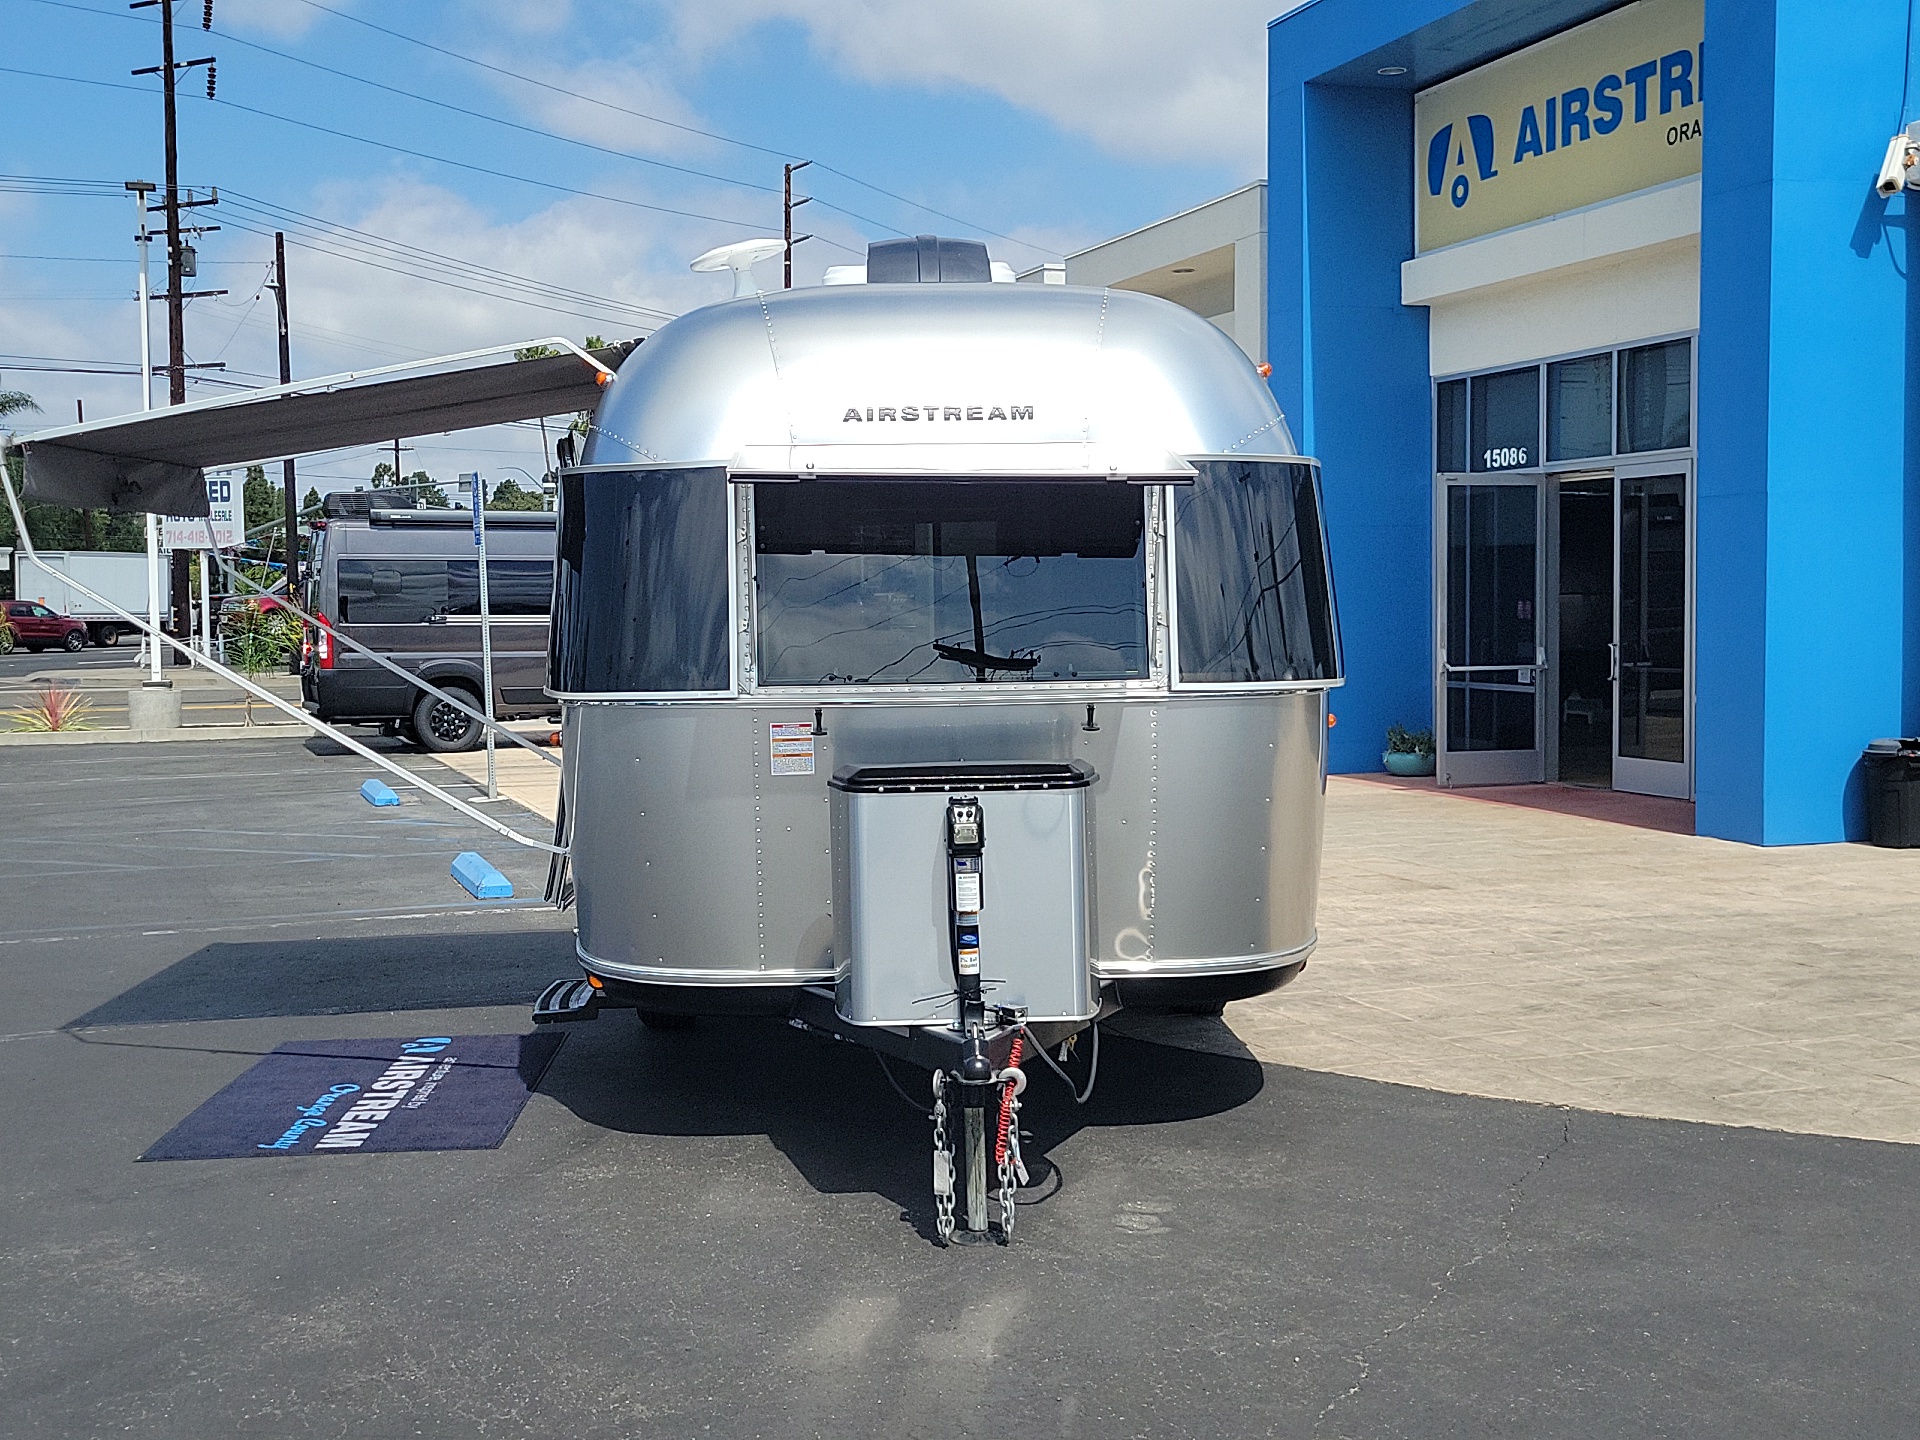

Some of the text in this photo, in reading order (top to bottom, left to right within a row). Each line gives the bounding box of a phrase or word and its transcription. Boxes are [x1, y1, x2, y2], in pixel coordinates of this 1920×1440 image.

[1513, 42, 1703, 164] AIRSTR
[1666, 119, 1703, 146] ORA
[842, 405, 1034, 423] AIRSTREAM
[1483, 447, 1528, 469] 15086
[207, 480, 231, 503] ED
[166, 529, 234, 545] 714-418-012
[314, 1055, 436, 1149] AIRSTREAM
[257, 1083, 361, 1150] Orange County
